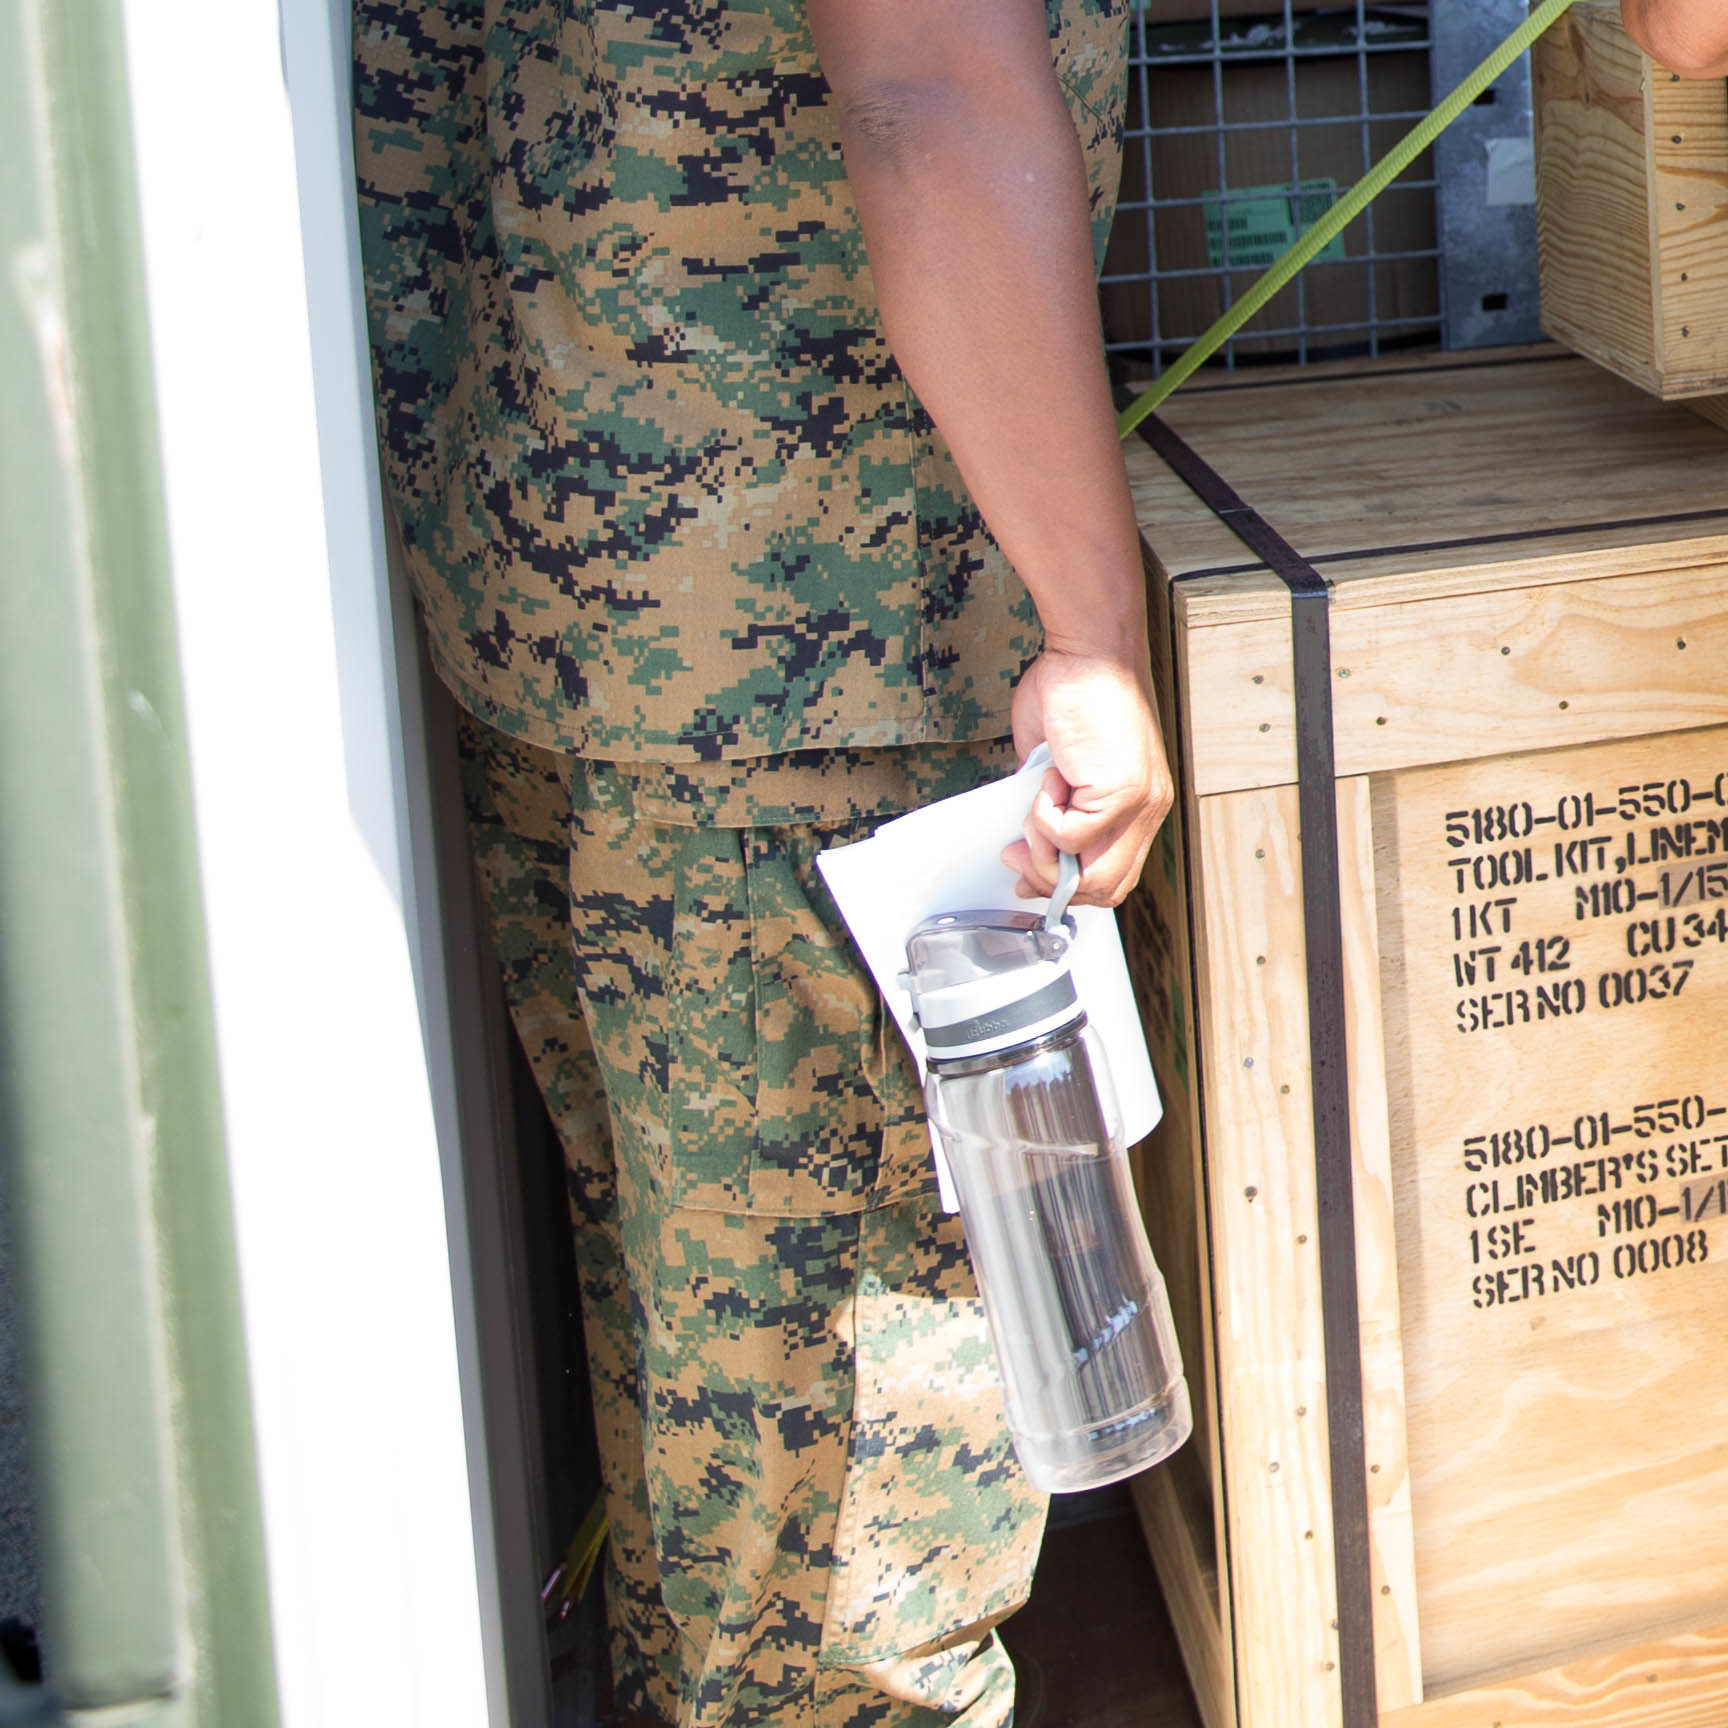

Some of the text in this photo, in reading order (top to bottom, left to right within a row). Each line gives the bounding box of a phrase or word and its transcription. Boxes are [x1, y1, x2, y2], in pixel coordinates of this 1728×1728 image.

[1448, 848, 1548, 894] TOOL
[1576, 862, 1728, 920] M10-1/15
[1454, 908, 1728, 987] WT 412 CU 34
[1456, 959, 1694, 1033] SER NO 0037
[1467, 1149, 1659, 1218] CLIMBER'S
[1472, 1229, 1708, 1308] SER NO 0008
